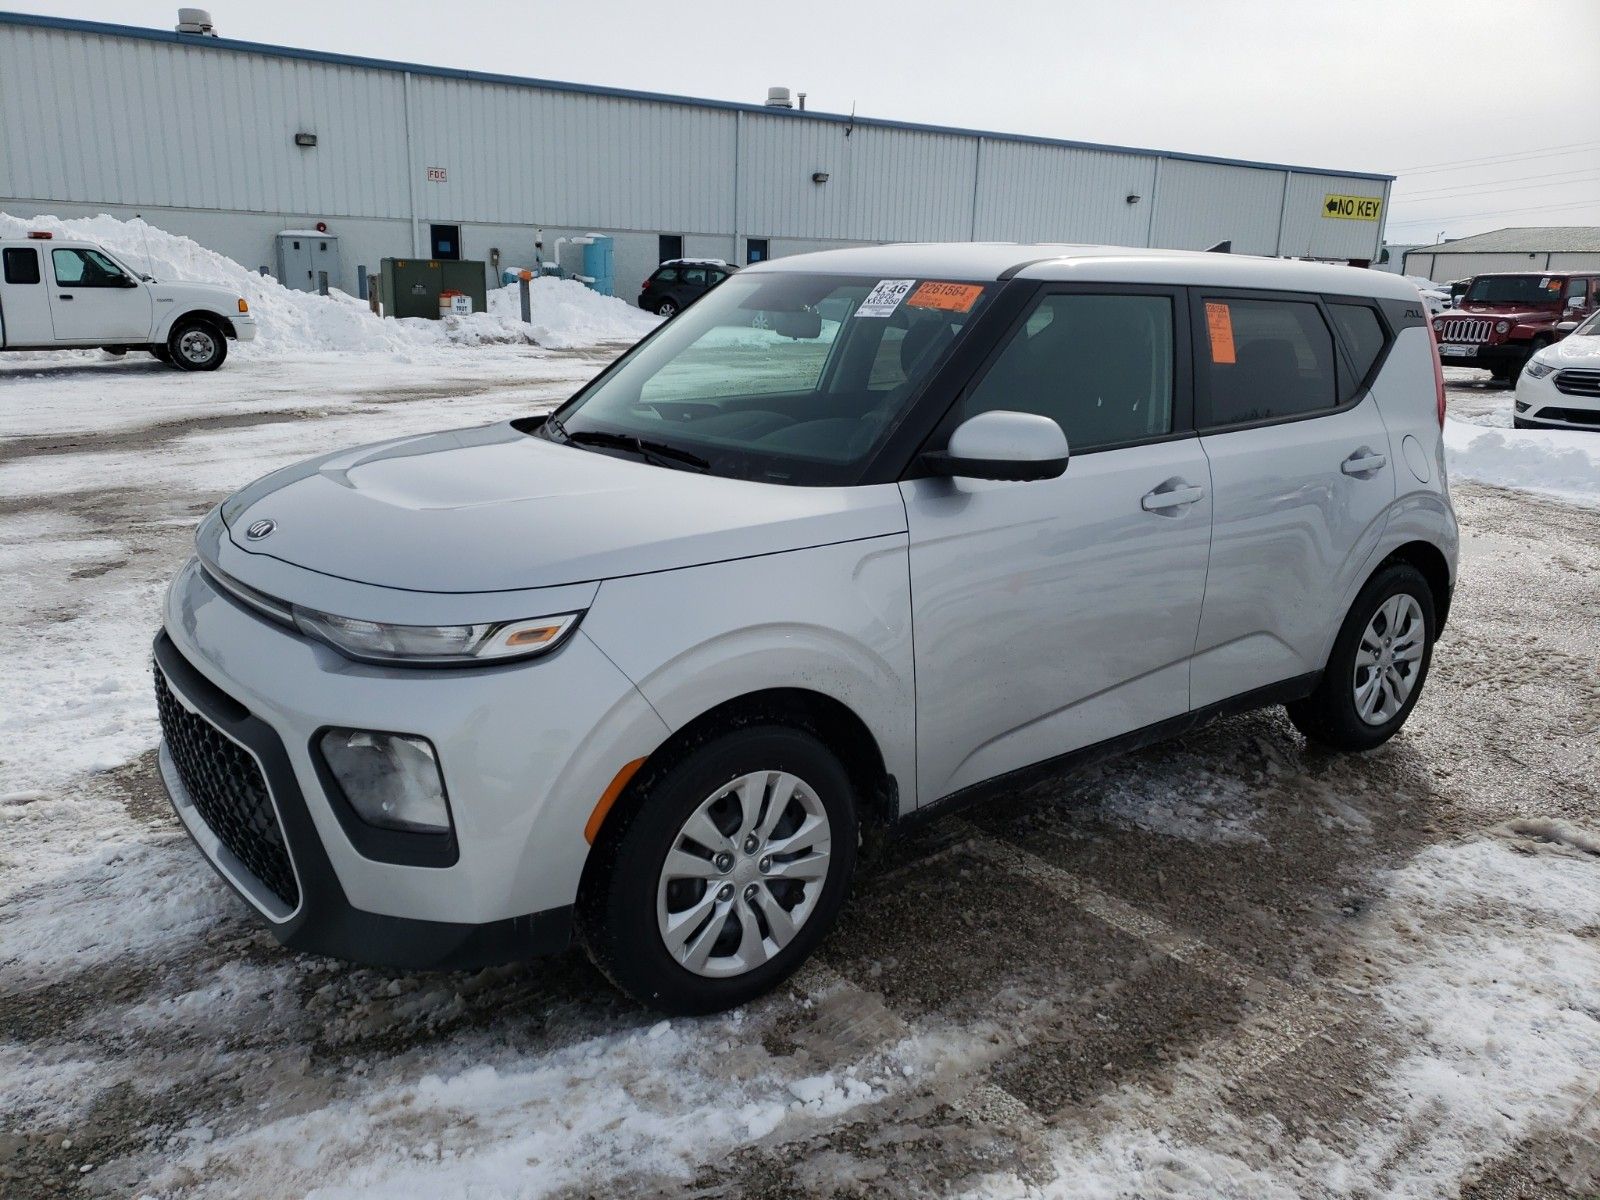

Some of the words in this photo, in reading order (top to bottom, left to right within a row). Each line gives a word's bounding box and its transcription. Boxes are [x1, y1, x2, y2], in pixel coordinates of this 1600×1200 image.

[430, 170, 445, 179] FDC
[1337, 199, 1354, 216] NO
[1357, 201, 1380, 217] KEY
[920, 283, 968, 296] 2261564
